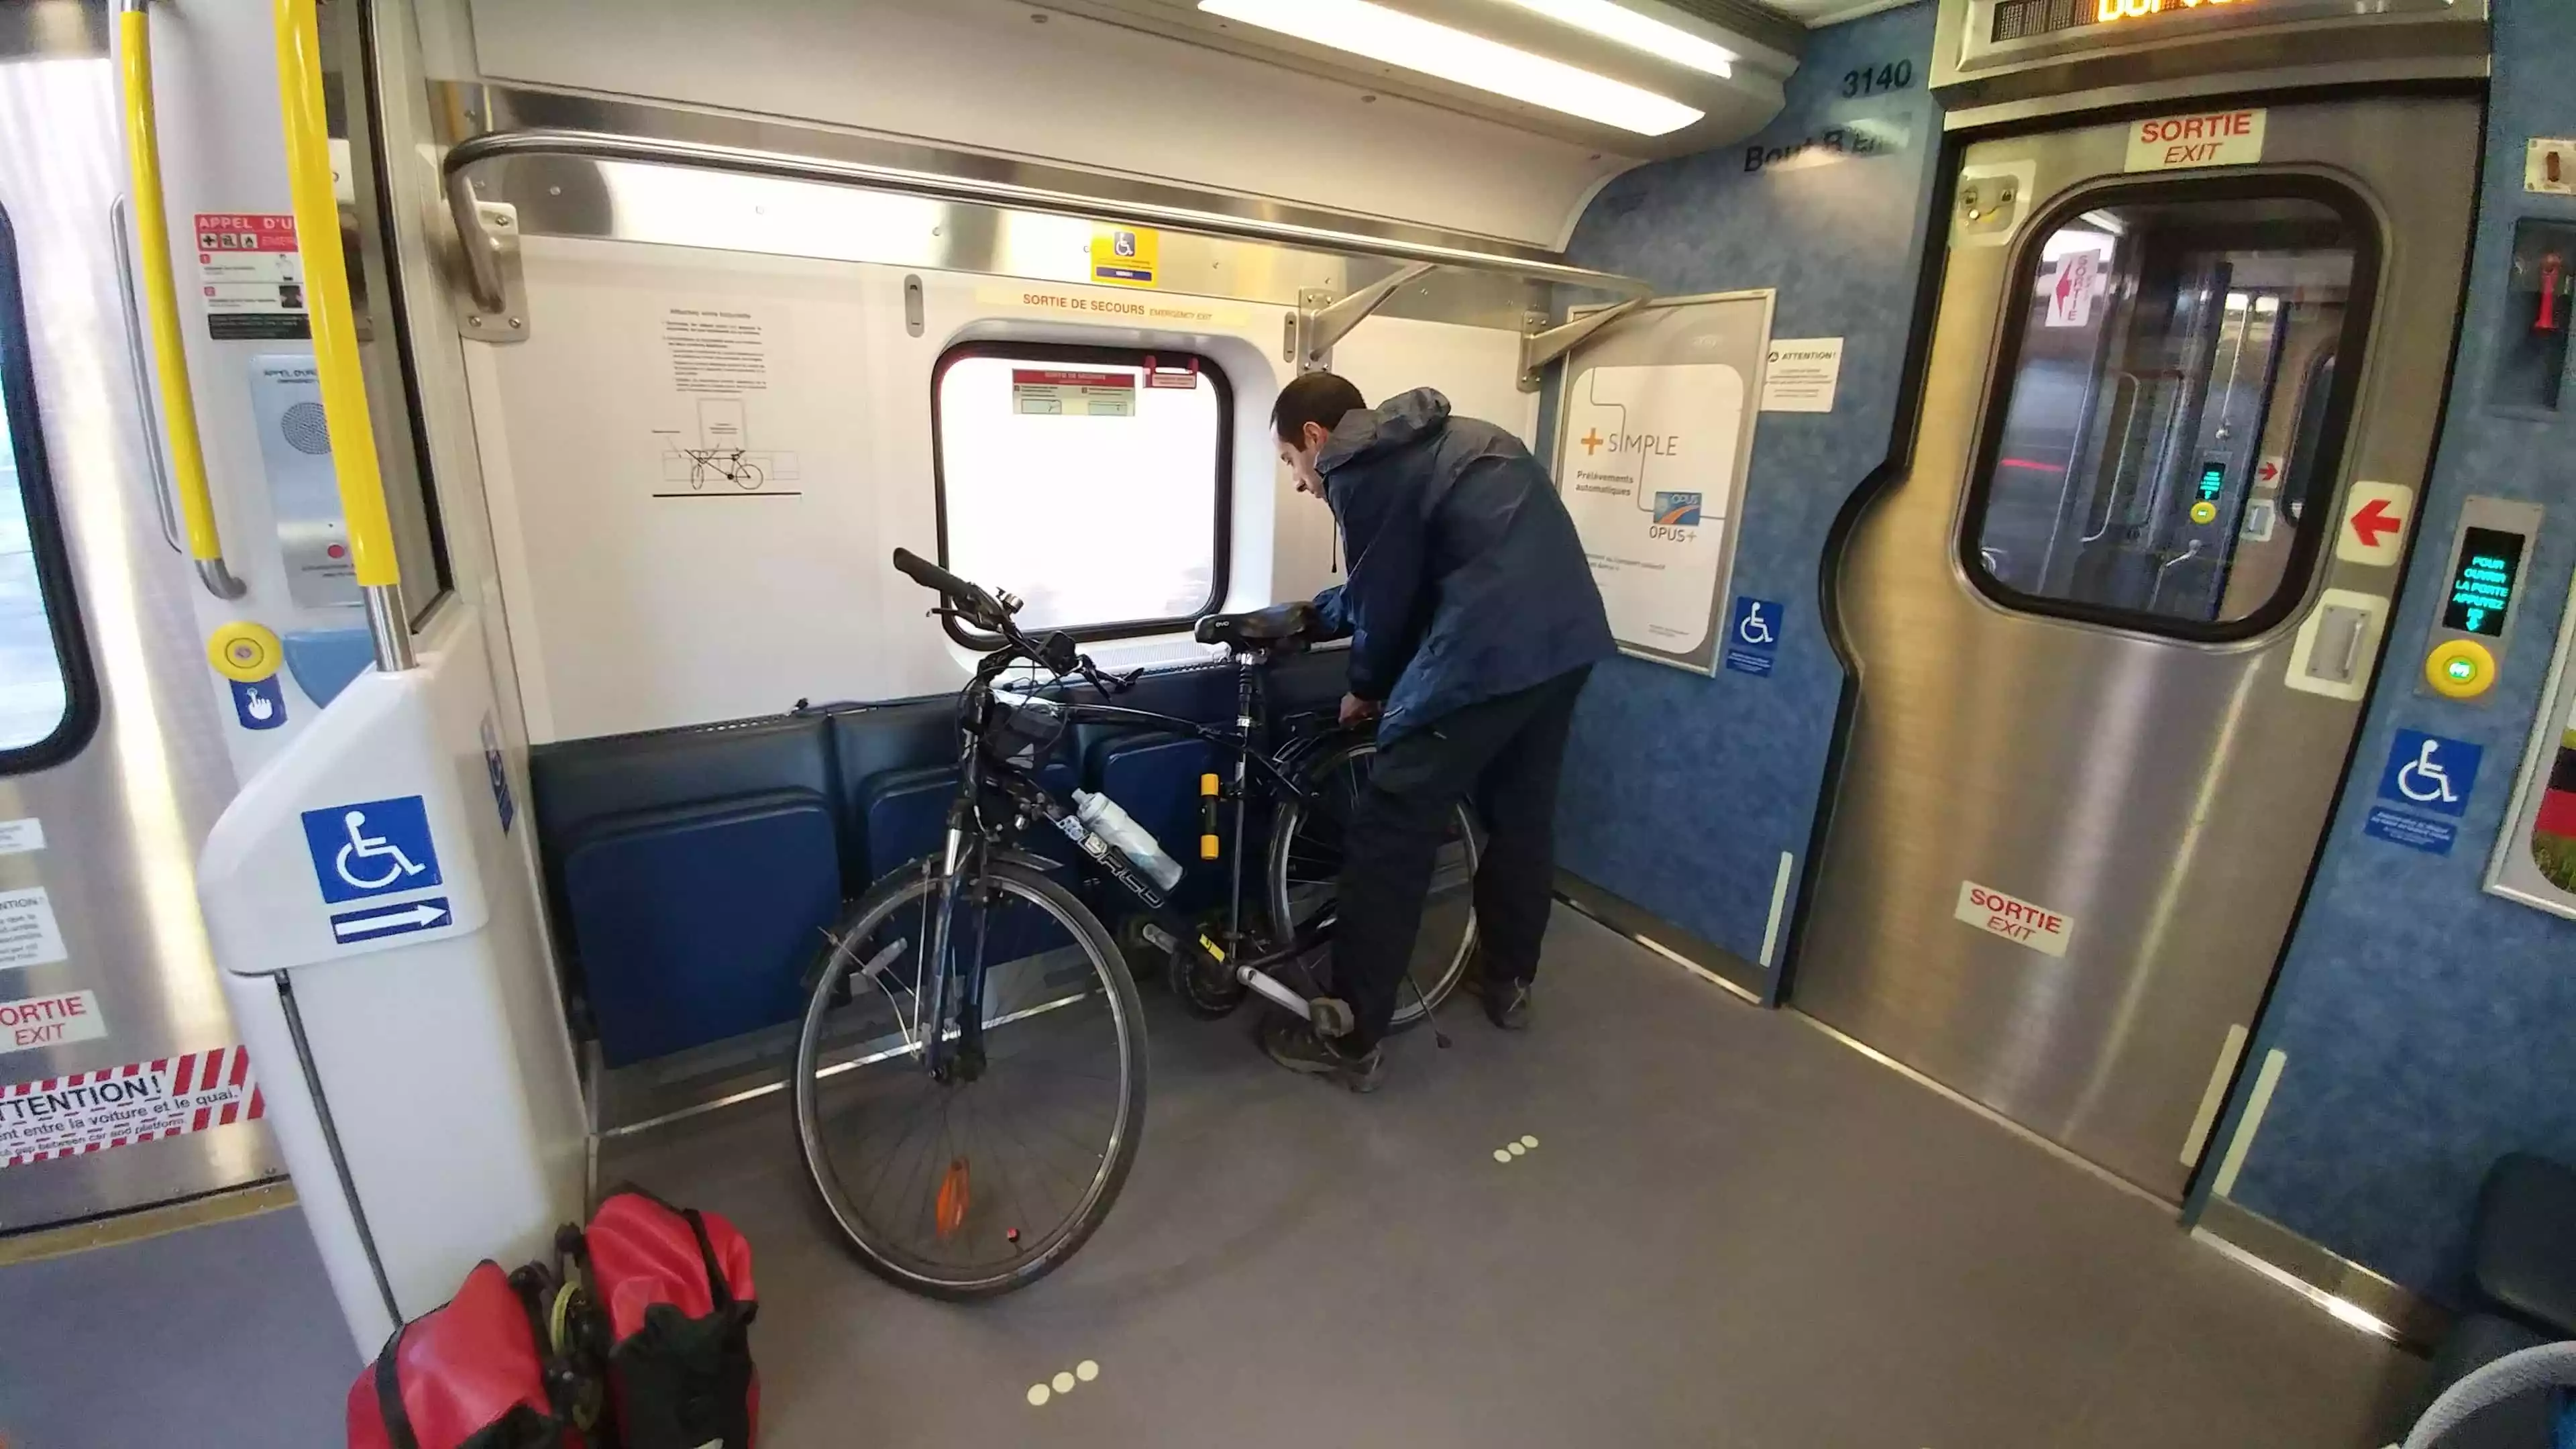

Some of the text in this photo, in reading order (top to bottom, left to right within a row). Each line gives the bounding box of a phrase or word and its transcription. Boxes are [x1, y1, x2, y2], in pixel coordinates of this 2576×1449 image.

[1842, 58, 1913, 98] 3140
[2141, 113, 2251, 143] SORTIE
[2164, 142, 2224, 164] EXIT
[199, 217, 253, 229] APPEL
[2068, 255, 2088, 321] SORTIE
[1023, 293, 1067, 308] SORTIE
[1071, 299, 1087, 309] DE
[1090, 300, 1144, 315] SECOURS
[1781, 351, 1836, 360] ATTENTION!
[1608, 433, 1678, 457] SIMPLE
[2473, 556, 2506, 570] POUR
[2455, 580, 2470, 590] LA
[1970, 888, 2062, 934] SORTIE
[1987, 915, 2036, 941] EXIT
[0, 996, 87, 1026] ORTIE
[15, 1022, 66, 1046] EXIT
[23, 1122, 65, 1138] entre
[68, 1118, 85, 1130] la
[89, 1107, 148, 1126] voiture
[153, 1101, 171, 1114] et
[174, 1099, 191, 1108] le
[196, 1088, 239, 1106] quai.
